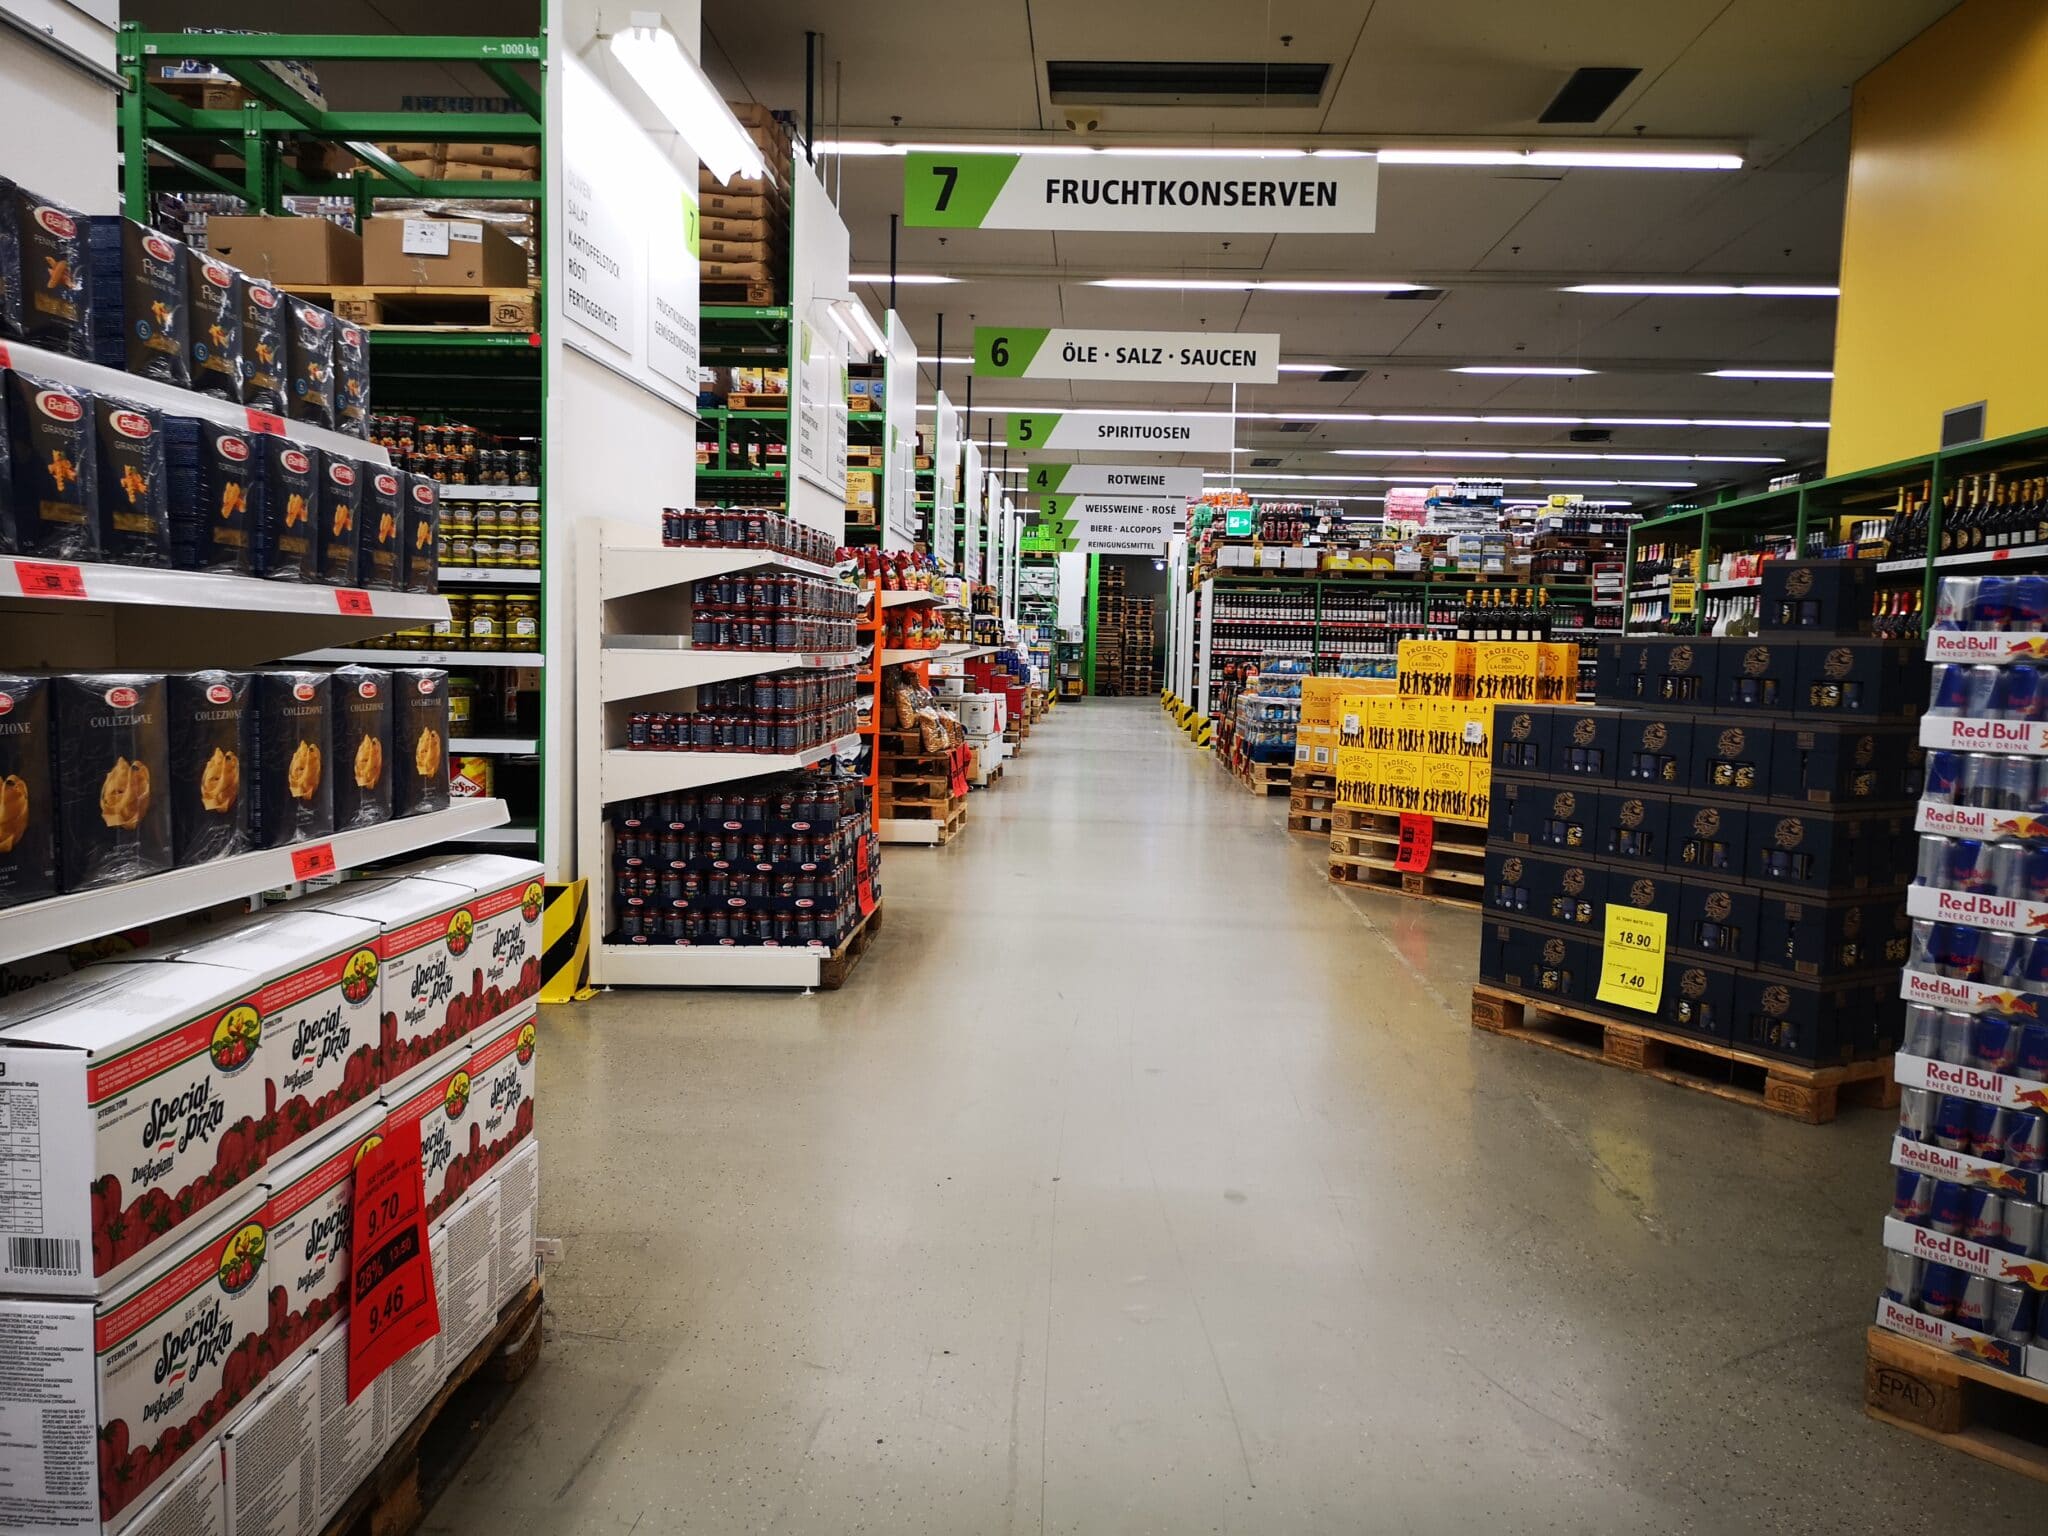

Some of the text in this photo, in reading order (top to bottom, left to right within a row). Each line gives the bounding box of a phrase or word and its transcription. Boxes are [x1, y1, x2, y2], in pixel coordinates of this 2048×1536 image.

[501, 43, 539, 57] 1000 kg
[932, 166, 959, 212] 7
[1045, 178, 1338, 207] FRUCHTKONSERVEN
[568, 229, 621, 279] KARTOFFELSTOCK
[499, 308, 518, 320] EPAL
[568, 288, 618, 332] FERTIGGERICHTE
[990, 337, 1009, 367] 6
[1062, 341, 1257, 367] ÖLE SALZ SAUCEN
[48, 397, 82, 416] Barilla
[121, 418, 150, 433] Barilla
[1019, 419, 1032, 441] 5
[1098, 425, 1190, 439] SPIRITUOSEN
[1037, 470, 1048, 487] 4
[1107, 474, 1166, 485] ROTWEINE
[1047, 500, 1057, 515] 3
[1085, 504, 1144, 514] WEISSWEINE
[1055, 522, 1063, 534] 2
[1090, 525, 1162, 534] BIERE ALCOPOPS
[1061, 538, 1067, 549] 1
[1088, 541, 1155, 550] REINIGUNGSMITTEL
[1407, 645, 1448, 659] PROSECCO
[1937, 636, 1998, 651] Red Bull
[1484, 647, 1530, 661] PROSECCO
[90, 714, 153, 728] COLLEZIONE
[195, 709, 242, 721] COLLEZIONE
[1953, 721, 2030, 741] Red Bull
[1952, 739, 2030, 751] ENERGY DRINK
[1342, 755, 1373, 769] PROSECCO
[1384, 759, 1416, 773] PROSECCO
[1429, 762, 1463, 777] PROSECCO
[1925, 807, 1985, 826] Red Bull
[1939, 893, 2016, 918] Red Bull
[1938, 911, 2015, 928] ENERGY DRINK
[493, 922, 521, 957] Special
[1619, 930, 1651, 947] 18.90
[411, 955, 447, 996] Special
[1620, 972, 1645, 988] 1.40
[1911, 975, 1969, 999] Red Bull
[292, 1005, 341, 1061] Special
[1926, 1062, 2004, 1093] Red Bull
[491, 1067, 518, 1108] Special
[1926, 1079, 2001, 1102] ENERGY DRINK
[143, 1075, 211, 1148] Special
[1901, 1144, 1959, 1170] Red Bull
[368, 1191, 399, 1238] 9.70
[1914, 1229, 1990, 1265] Red Bull
[1914, 1247, 1989, 1275] ENERGY DRINK
[369, 1285, 404, 1334] 9.46
[1886, 1305, 1943, 1336] Red Bull
[155, 1299, 221, 1384] Special
